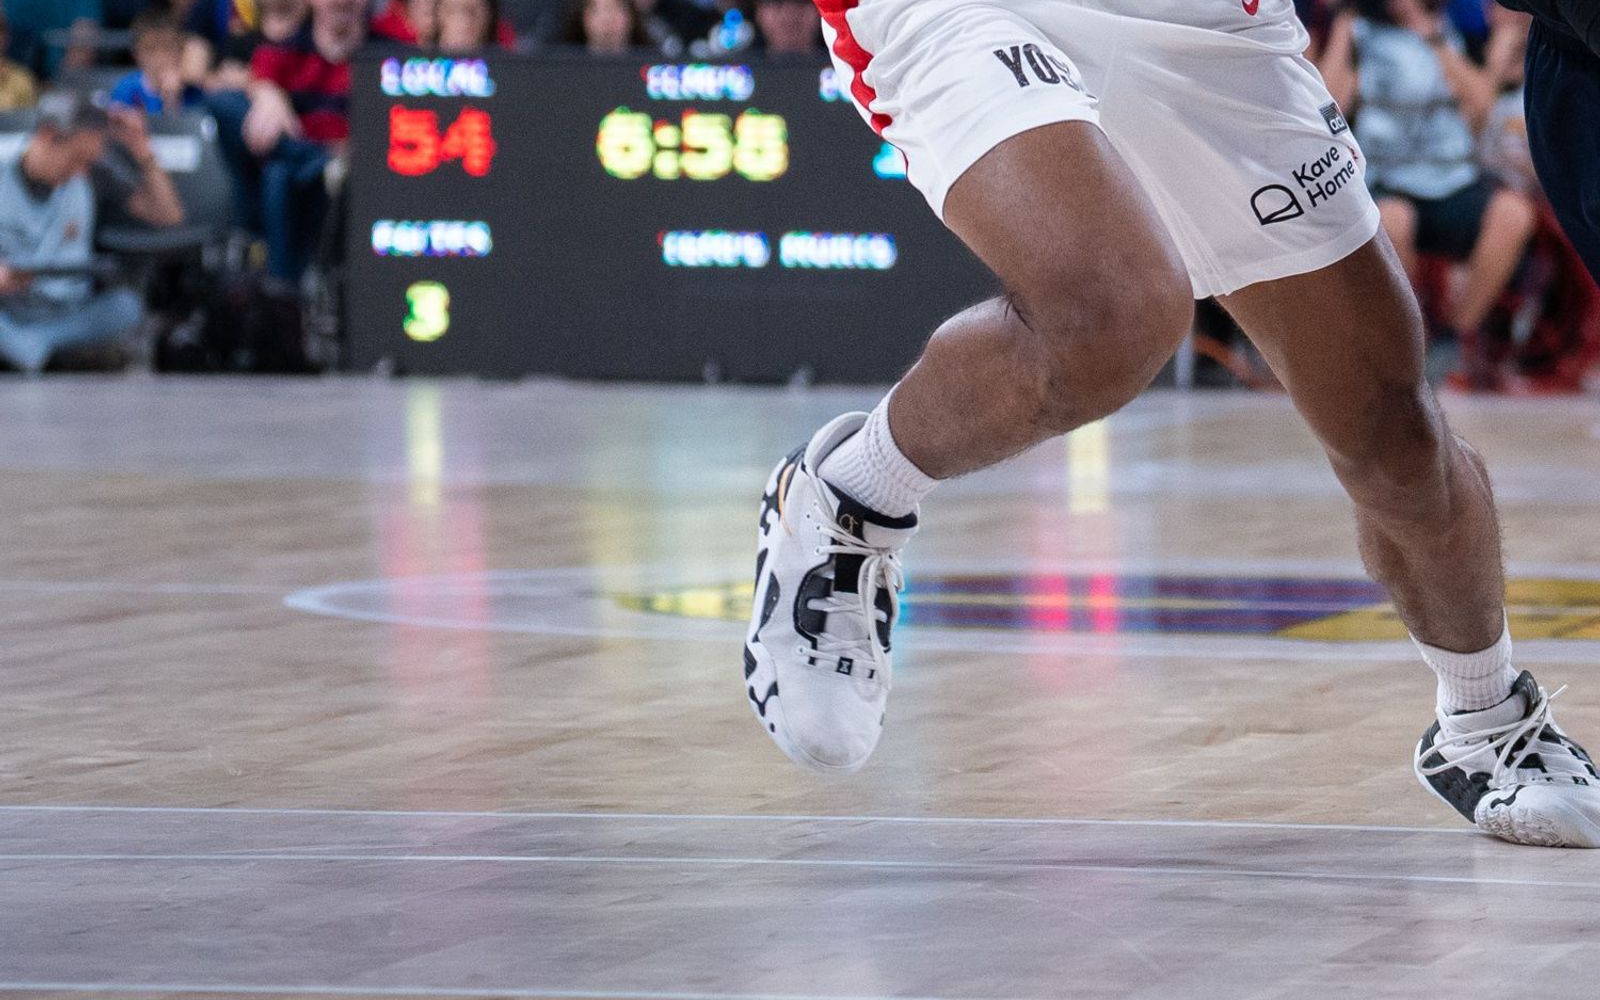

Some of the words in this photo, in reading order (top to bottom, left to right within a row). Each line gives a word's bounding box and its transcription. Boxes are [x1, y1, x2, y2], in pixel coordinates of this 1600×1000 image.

[387, 104, 496, 176] 54
[1292, 147, 1340, 188] Kave
[1306, 160, 1355, 208] Home
[403, 281, 450, 341] 3
